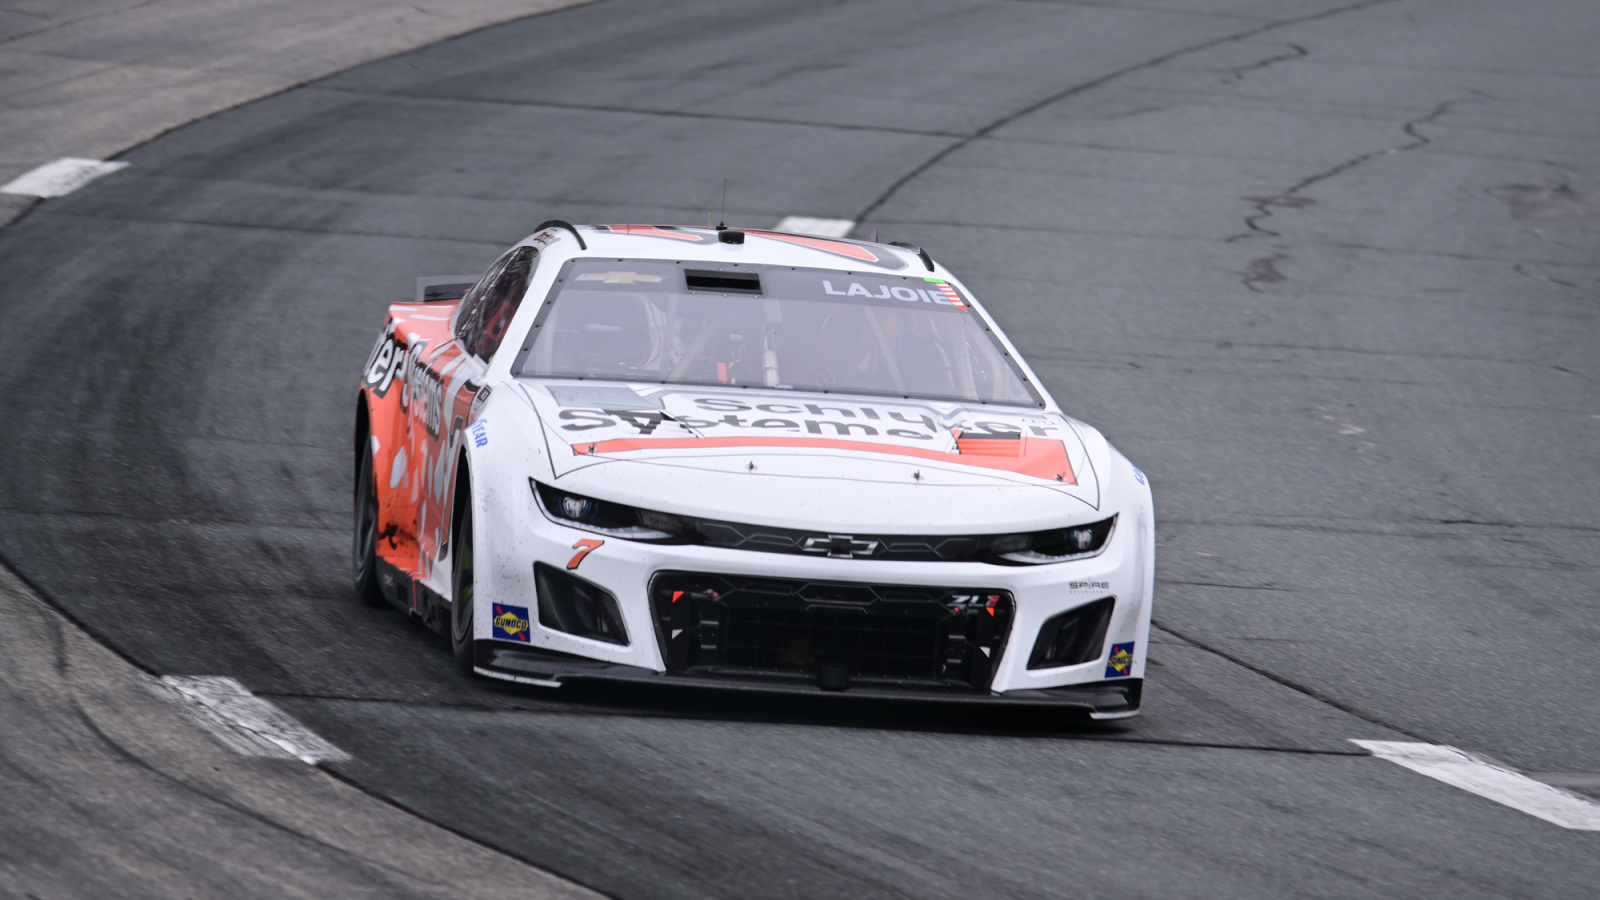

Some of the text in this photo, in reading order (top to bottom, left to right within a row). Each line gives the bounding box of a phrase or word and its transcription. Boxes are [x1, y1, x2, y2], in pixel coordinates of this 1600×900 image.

[822, 280, 953, 305] LAJOIE
[567, 539, 604, 569] 7
[1069, 580, 1110, 589] SPIRE
[494, 616, 528, 630] SUNOCO
